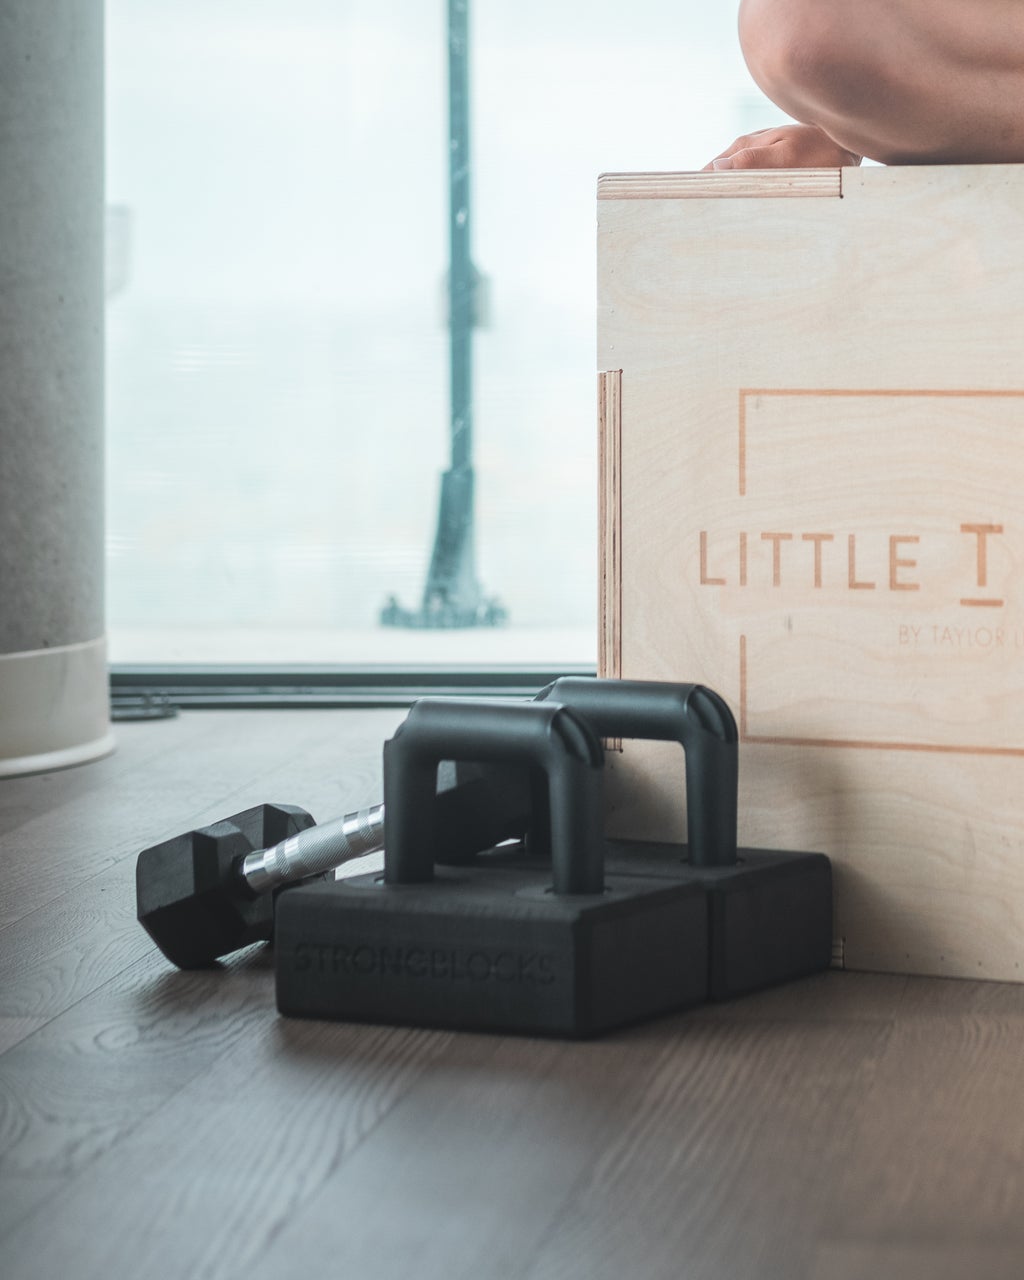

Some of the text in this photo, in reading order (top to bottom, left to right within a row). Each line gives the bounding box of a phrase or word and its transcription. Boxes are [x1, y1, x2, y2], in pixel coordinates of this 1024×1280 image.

[700, 531, 920, 591] LITTLE
[960, 522, 1004, 607] T
[899, 624, 921, 645] BY
[932, 624, 1006, 648] TAYLOR
[295, 943, 556, 985] STRONGBLOCKS
